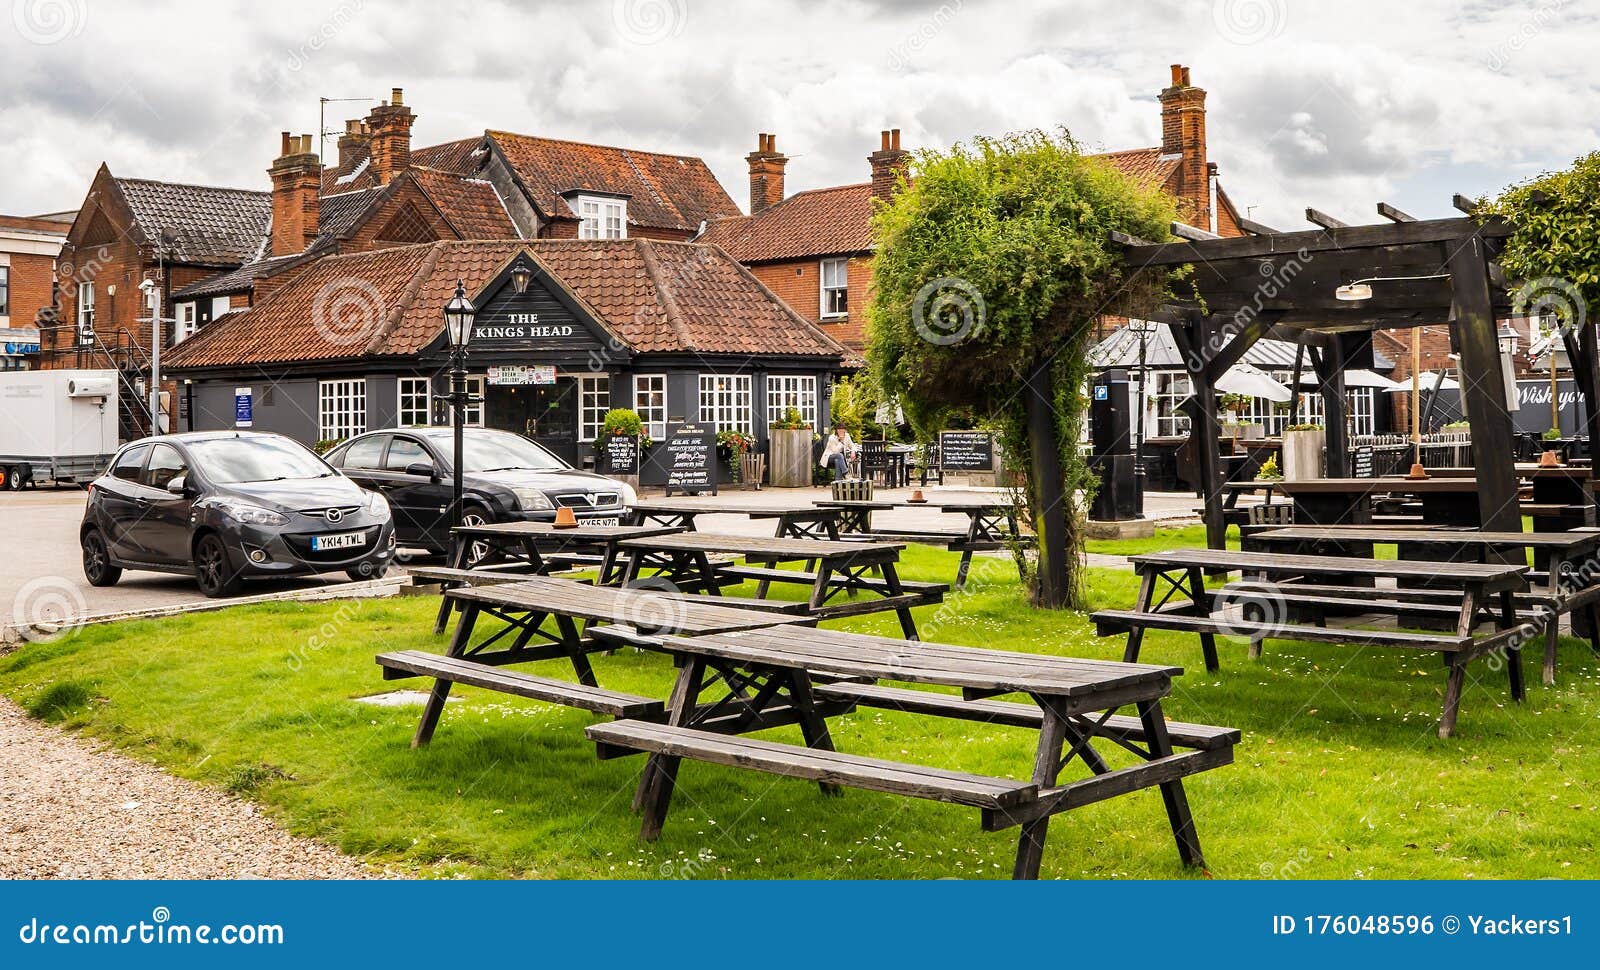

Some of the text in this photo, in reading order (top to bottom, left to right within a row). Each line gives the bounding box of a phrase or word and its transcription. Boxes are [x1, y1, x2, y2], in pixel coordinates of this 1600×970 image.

[508, 313, 539, 324] THE
[475, 326, 572, 338] KINGS HEAD
[1516, 386, 1553, 405] Wish
[321, 536, 342, 548] YK14
[345, 534, 362, 545] TWL
